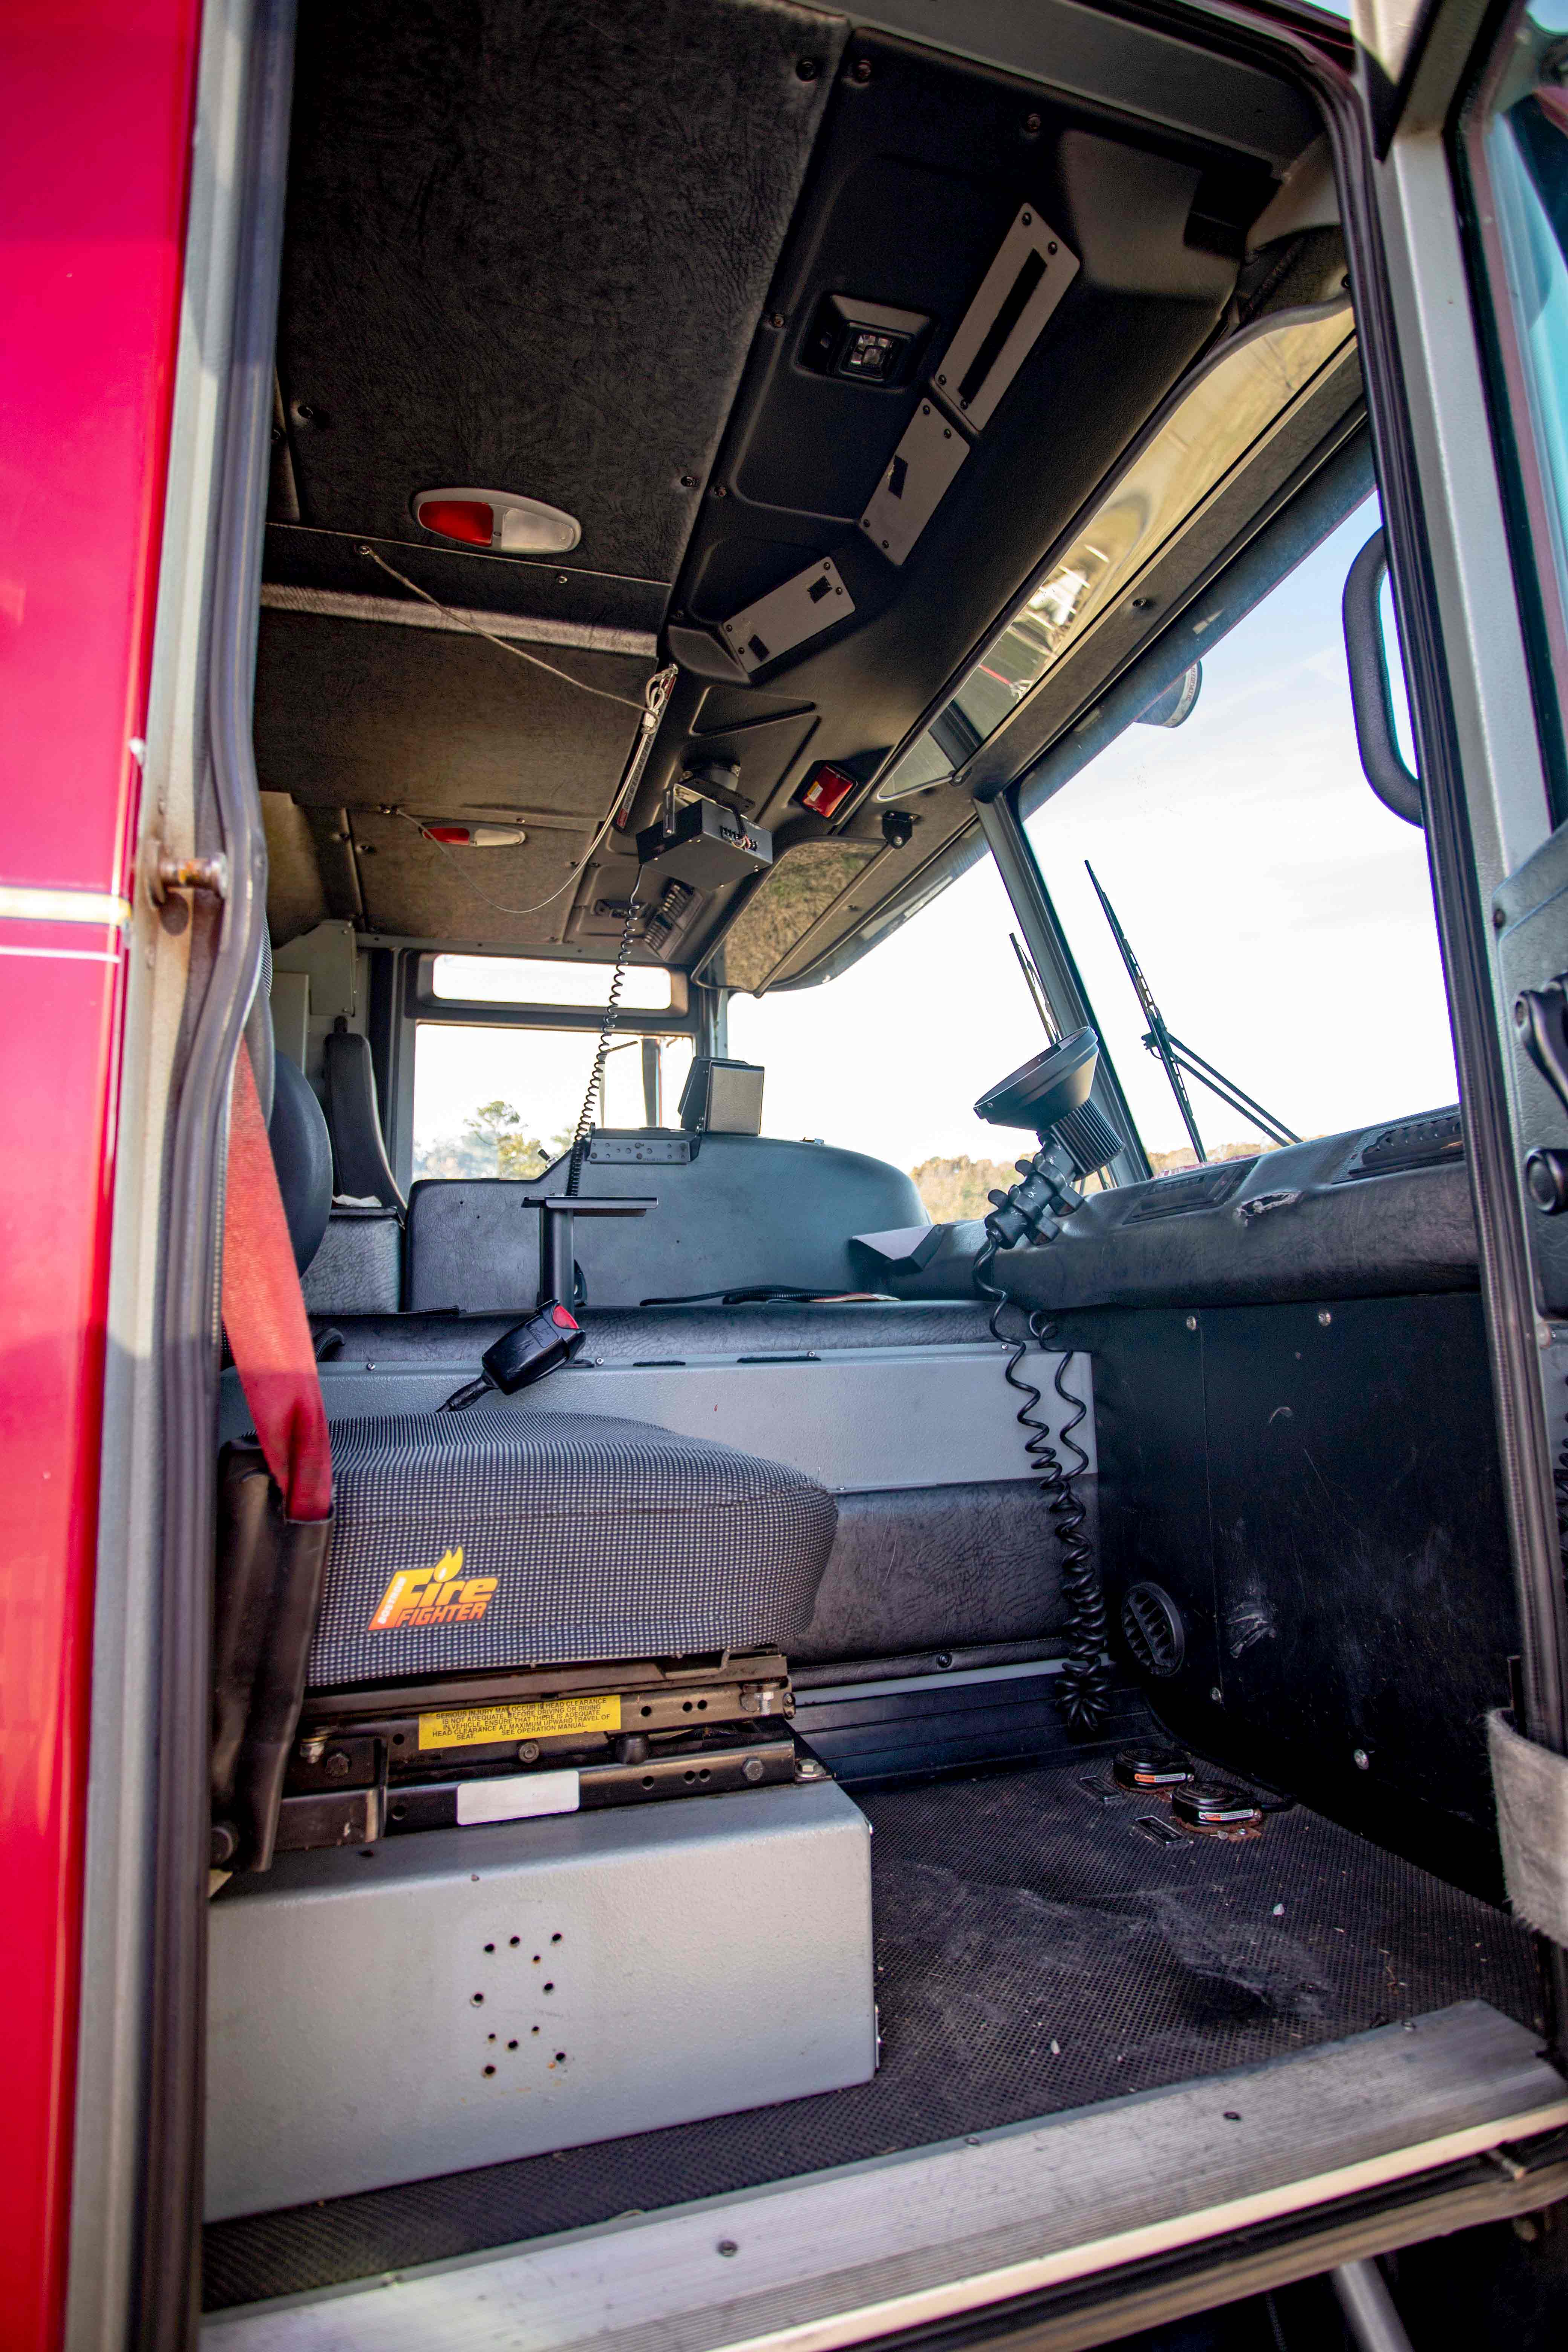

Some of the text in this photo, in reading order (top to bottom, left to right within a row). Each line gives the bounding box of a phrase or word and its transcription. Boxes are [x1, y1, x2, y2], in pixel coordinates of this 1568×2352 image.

[368, 1545, 499, 1631] Fire
[395, 1602, 488, 1628] FIGHTER
[436, 1711, 467, 1719] SERIOUS
[566, 1698, 606, 1707] CLEARANCE
[454, 1725, 498, 1735] CLEARANCE
[517, 1725, 556, 1734] OPERATION
